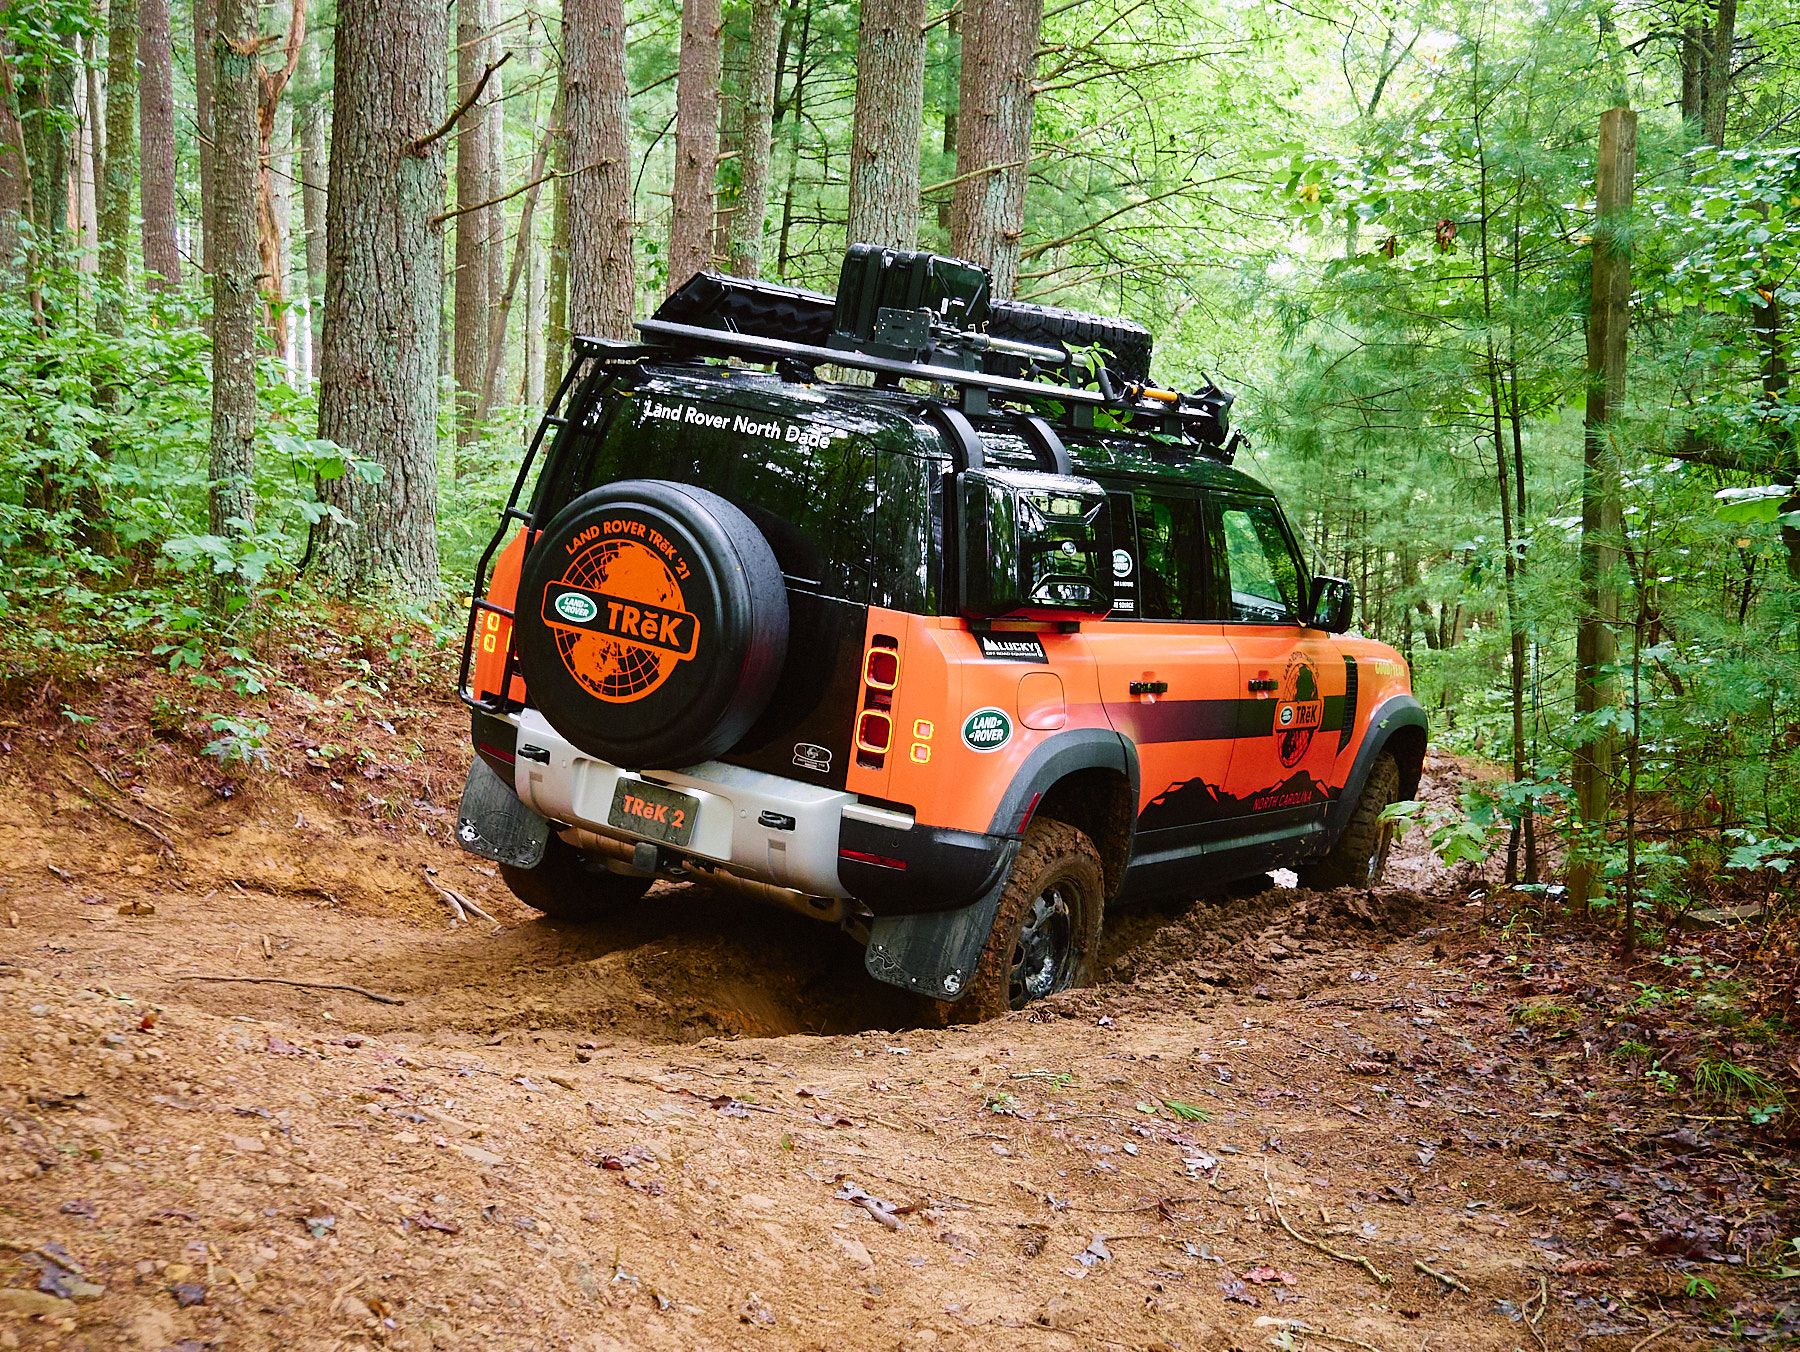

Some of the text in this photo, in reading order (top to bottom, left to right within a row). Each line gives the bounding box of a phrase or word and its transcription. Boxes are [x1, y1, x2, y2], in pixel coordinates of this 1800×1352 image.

[647, 400, 831, 449] Land Rover North Dade
[565, 525, 600, 555] LAND
[603, 520, 645, 539] ROVER
[564, 597, 585, 608] LAND
[564, 605, 590, 617] ROVER
[972, 716, 997, 730] LAND
[973, 729, 1004, 742] ROVER
[1253, 791, 1312, 811] NORTH CAROLINA
[671, 809, 685, 828] 2
